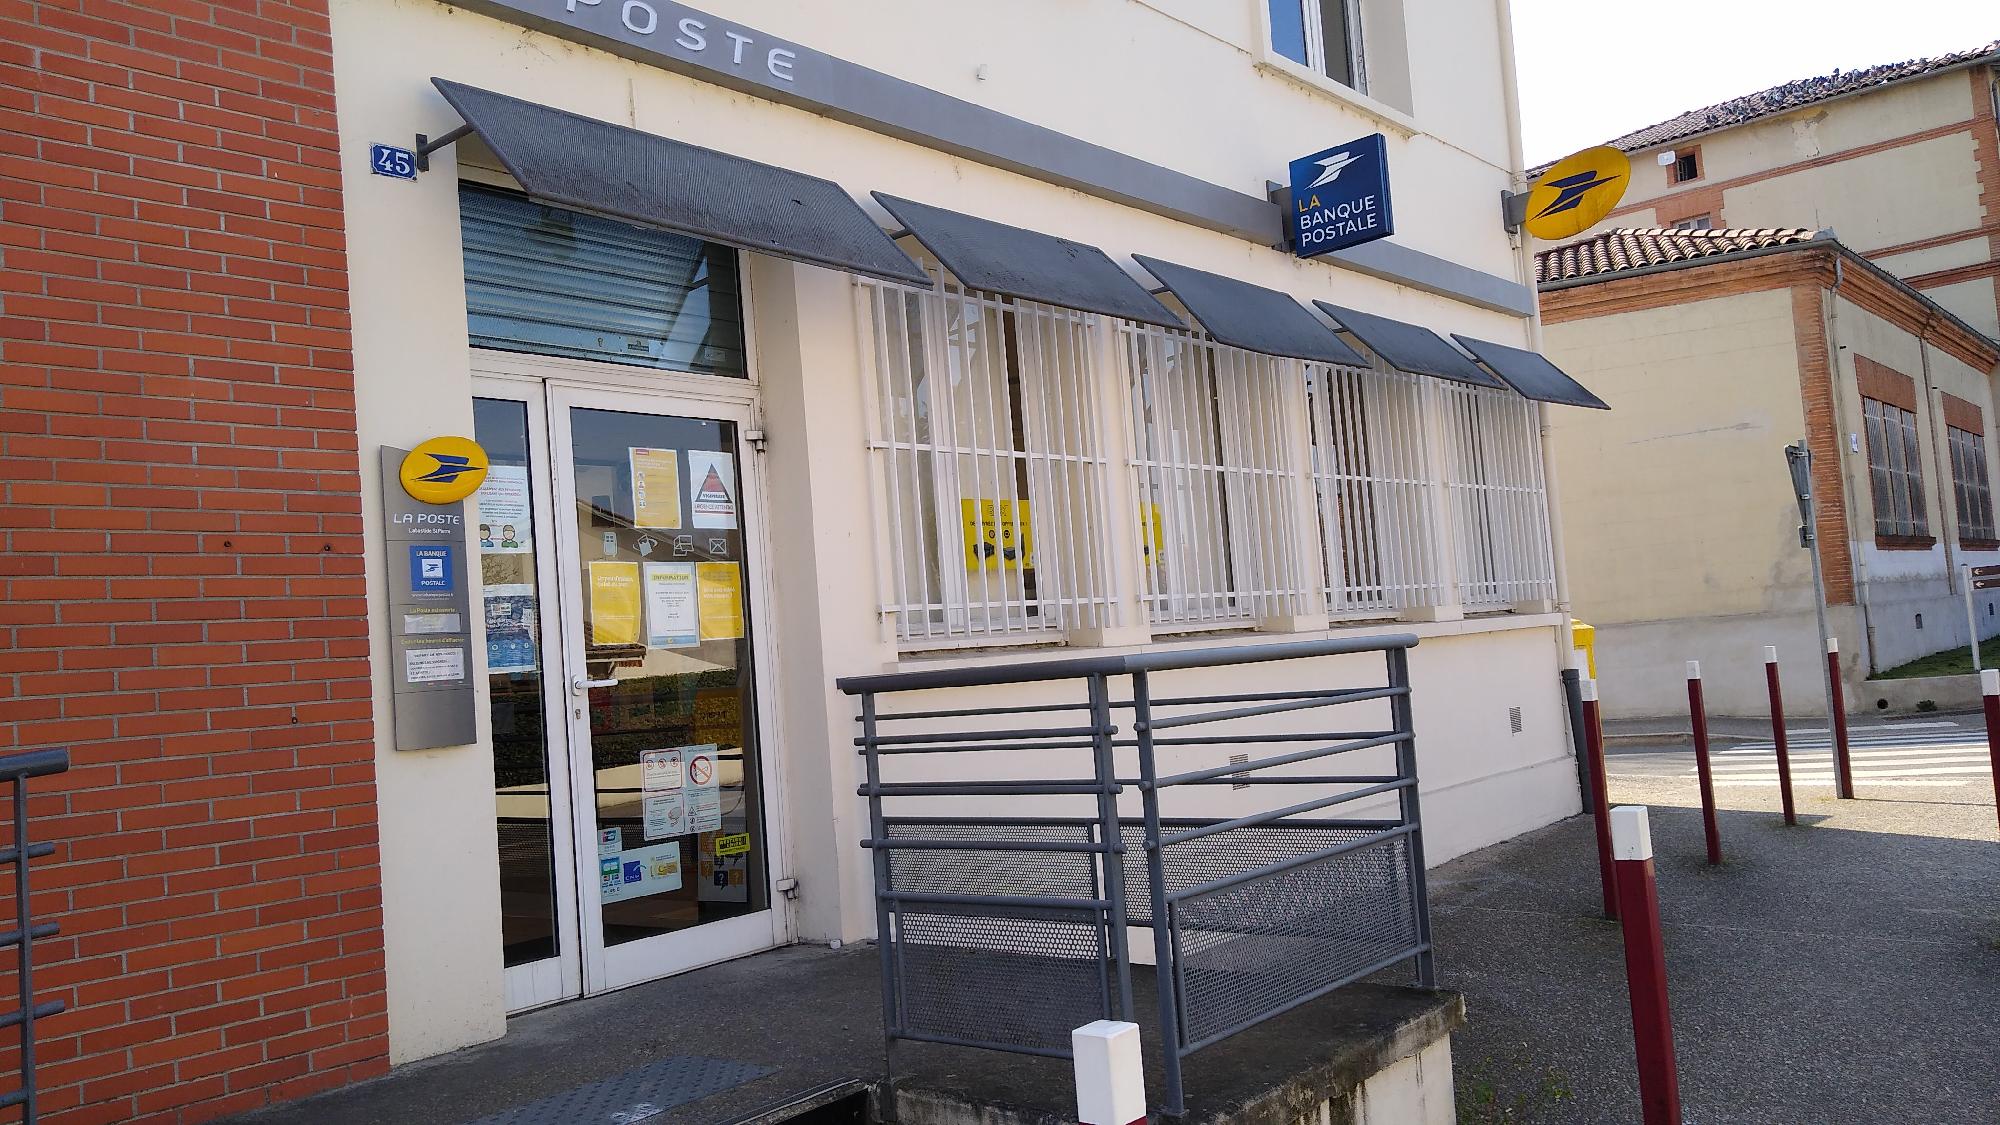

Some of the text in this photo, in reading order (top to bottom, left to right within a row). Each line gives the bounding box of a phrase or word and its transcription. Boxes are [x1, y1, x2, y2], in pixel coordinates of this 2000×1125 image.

[377, 149, 412, 176] 45
[1298, 194, 1321, 213] LA
[1300, 194, 1376, 230] BANQUE
[1301, 213, 1378, 248] POSTALE
[393, 513, 460, 525] LA POSTE
[424, 550, 448, 558] BANQUE
